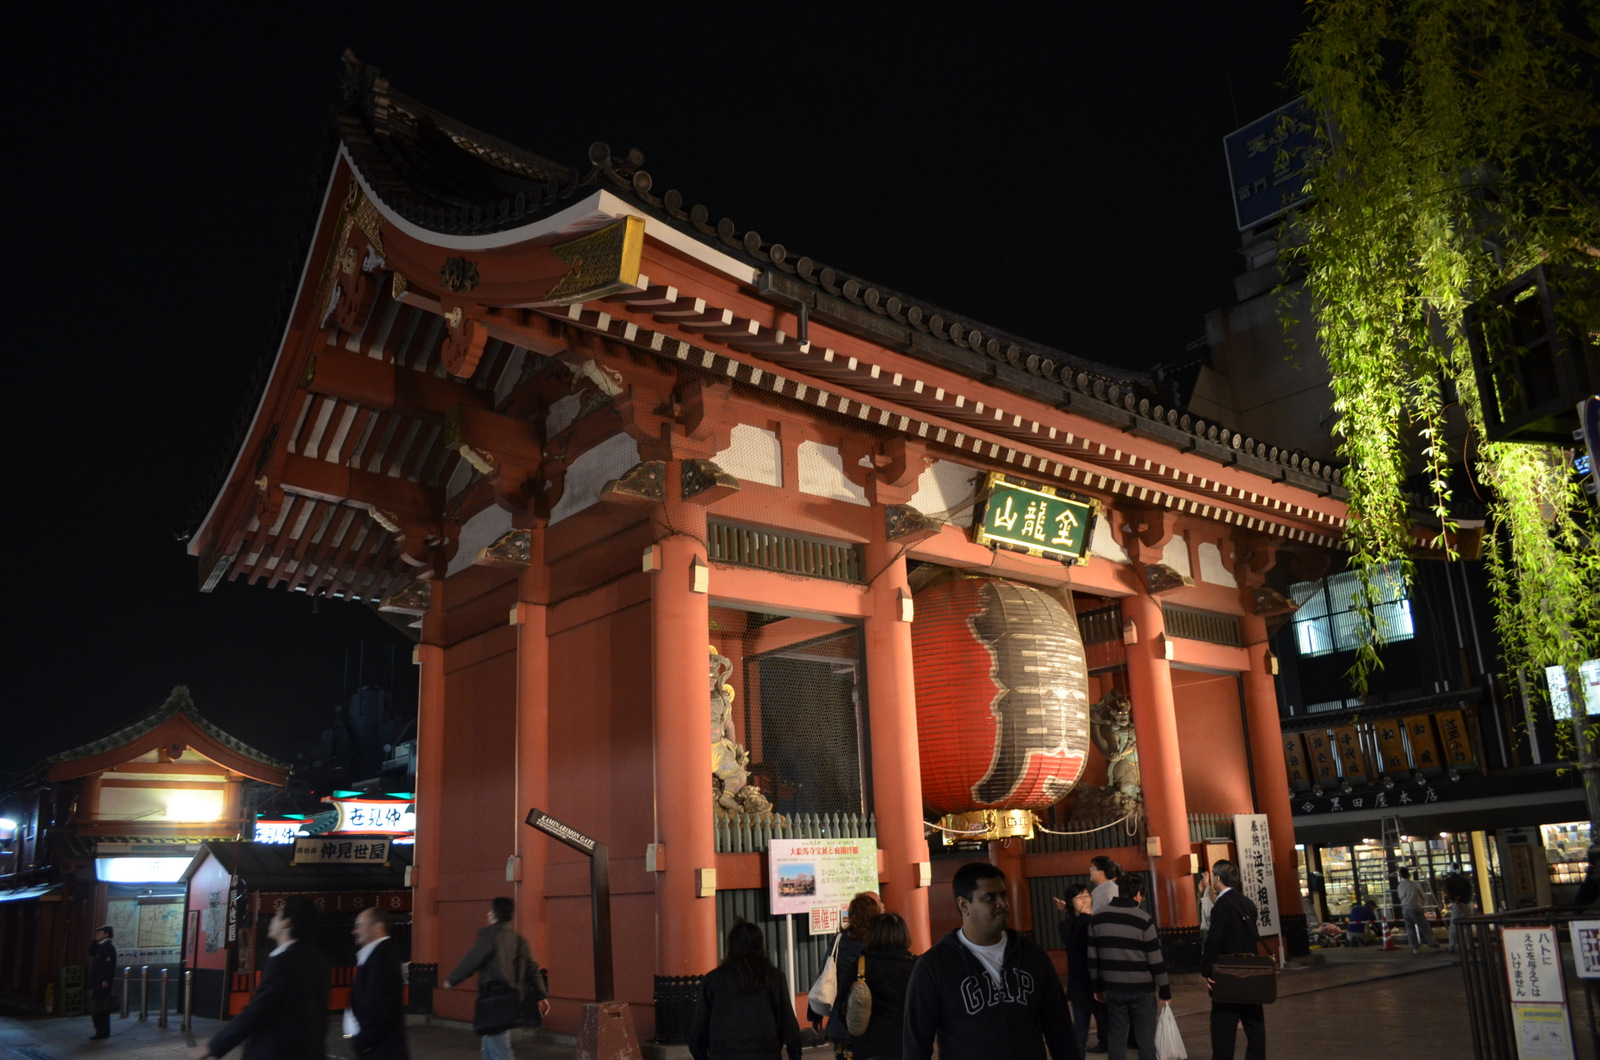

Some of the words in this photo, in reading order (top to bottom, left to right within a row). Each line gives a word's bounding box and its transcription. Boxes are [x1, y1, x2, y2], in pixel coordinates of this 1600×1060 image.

[1330, 788, 1439, 812] 黒田屋本店
[540, 814, 580, 839] KAMINARIMON
[579, 834, 596, 847] GATE
[320, 842, 386, 860] 仲見世屋
[1523, 933, 1541, 997] えさを与えては
[1538, 932, 1552, 966] ハトに
[960, 967, 1035, 1016] GAP
[1511, 951, 1526, 998] いけません
